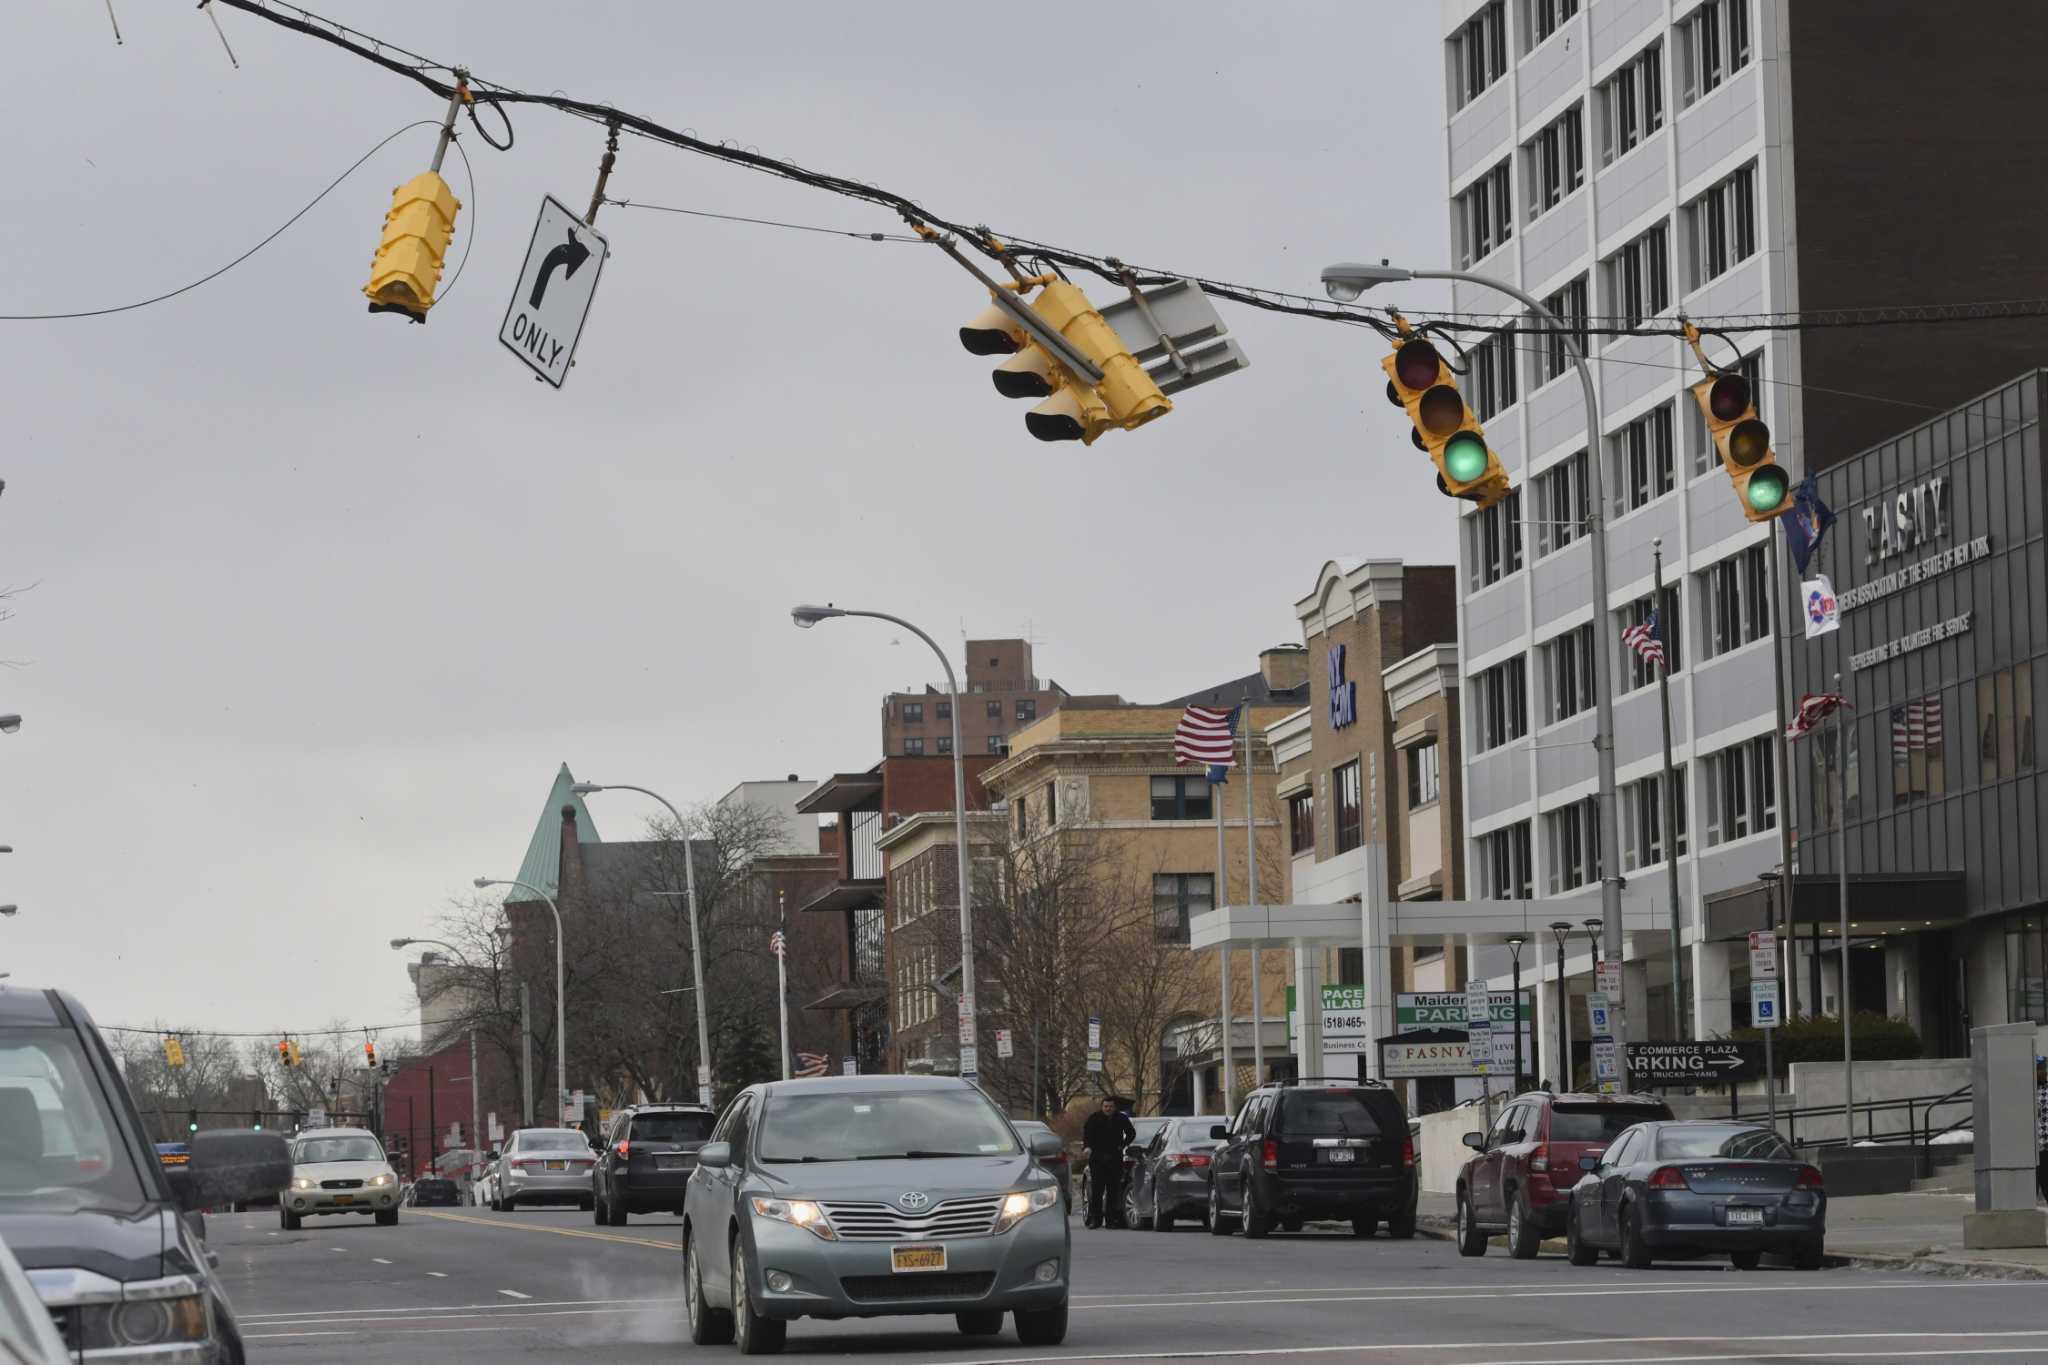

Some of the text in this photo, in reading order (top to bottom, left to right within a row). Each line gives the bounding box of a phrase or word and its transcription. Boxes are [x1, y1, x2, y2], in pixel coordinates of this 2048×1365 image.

[513, 313, 564, 368] ONLY
[1899, 568, 1907, 589] OF
[1908, 562, 1922, 585] THE
[1922, 554, 1942, 579] STATE
[1943, 549, 1953, 571] OF
[1954, 543, 1969, 566] NEW
[1970, 535, 1990, 560] YORK
[1323, 989, 1363, 999] PACE
[1406, 1046, 1465, 1059] FASNY
[1640, 1046, 1700, 1055] COMMERCE
[1705, 1045, 1739, 1054] PLAZA
